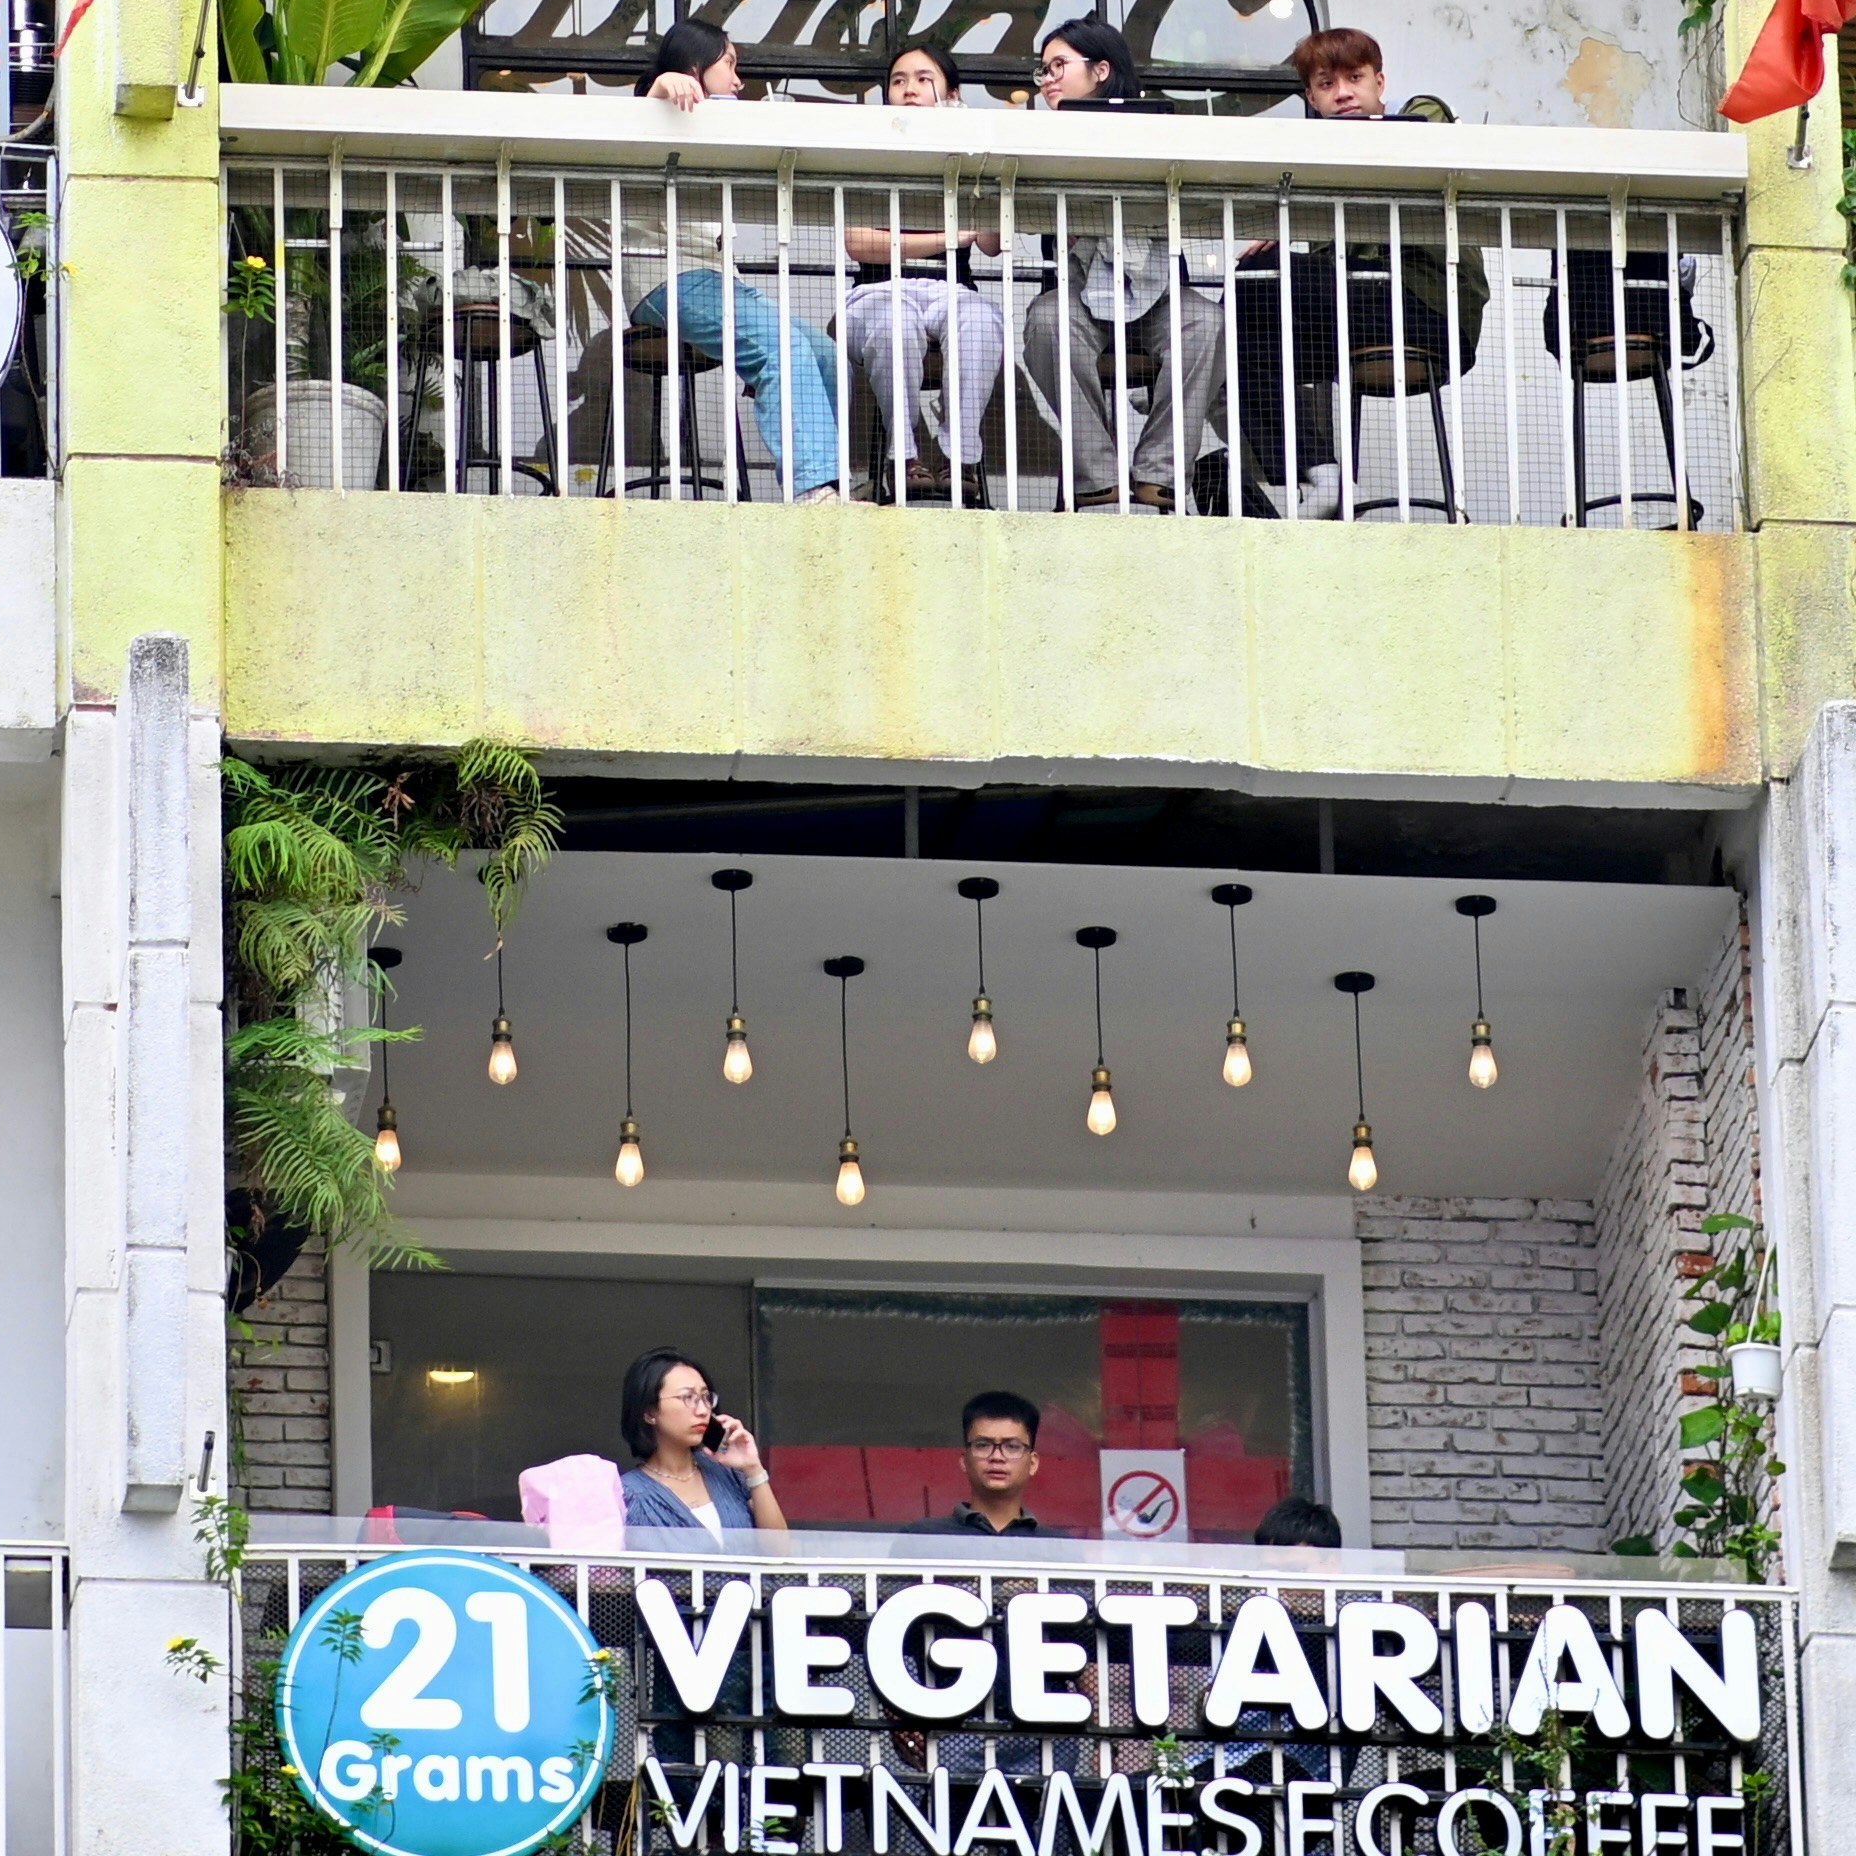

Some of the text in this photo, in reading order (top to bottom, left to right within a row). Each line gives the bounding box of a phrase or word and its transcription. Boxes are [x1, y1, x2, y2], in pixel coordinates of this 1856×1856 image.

[359, 1587, 531, 1733] 21
[633, 1578, 1762, 1743] VEGETARIAN
[319, 1740, 576, 1803] Grams
